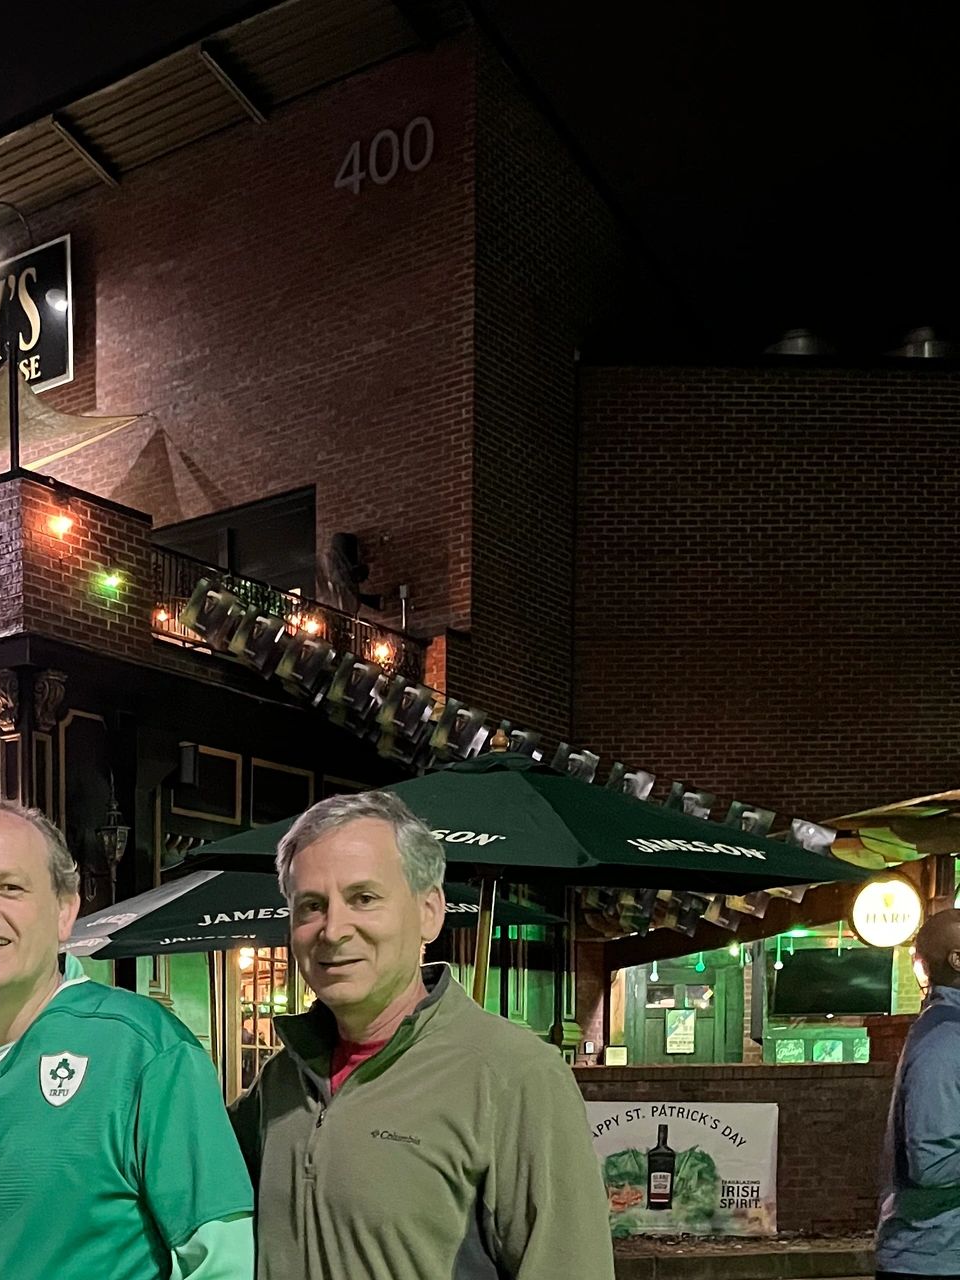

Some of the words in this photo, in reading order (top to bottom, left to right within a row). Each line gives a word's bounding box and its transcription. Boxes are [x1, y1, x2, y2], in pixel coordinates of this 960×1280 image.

[334, 116, 434, 195] 400
[627, 838, 767, 860] JAMESON
[49, 1088, 69, 1096] IRFU
[651, 1104, 721, 1130] PATRICK'S
[722, 1125, 747, 1149] DAY
[721, 1185, 760, 1198] IRISH
